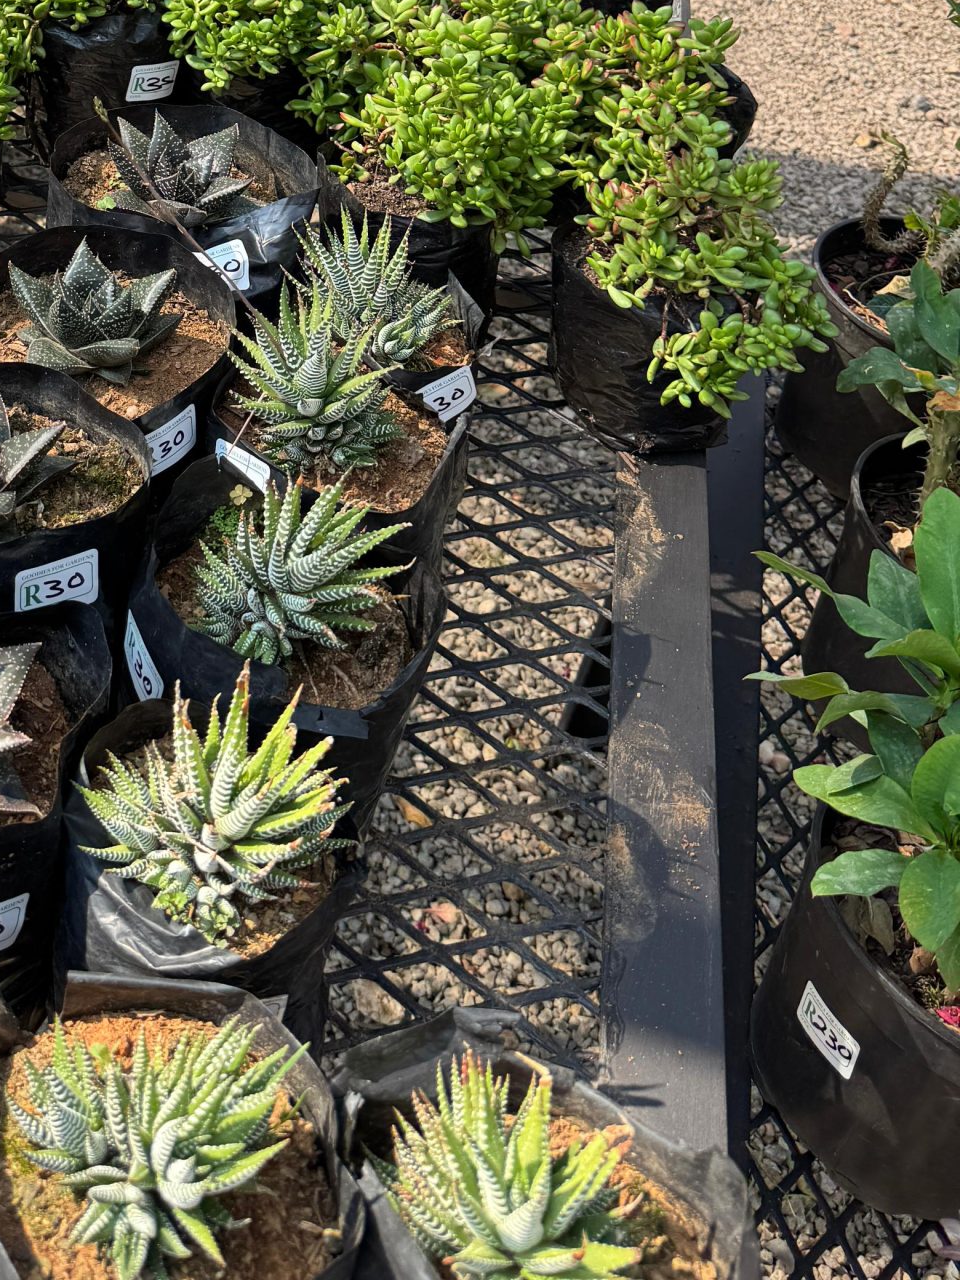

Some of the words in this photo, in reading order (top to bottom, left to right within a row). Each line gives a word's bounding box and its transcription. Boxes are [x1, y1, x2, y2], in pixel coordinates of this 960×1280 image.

[52, 564, 65, 572] FOR
[65, 554, 95, 567] GARDENS
[24, 572, 85, 608] R30
[805, 1000, 852, 1060] R230
